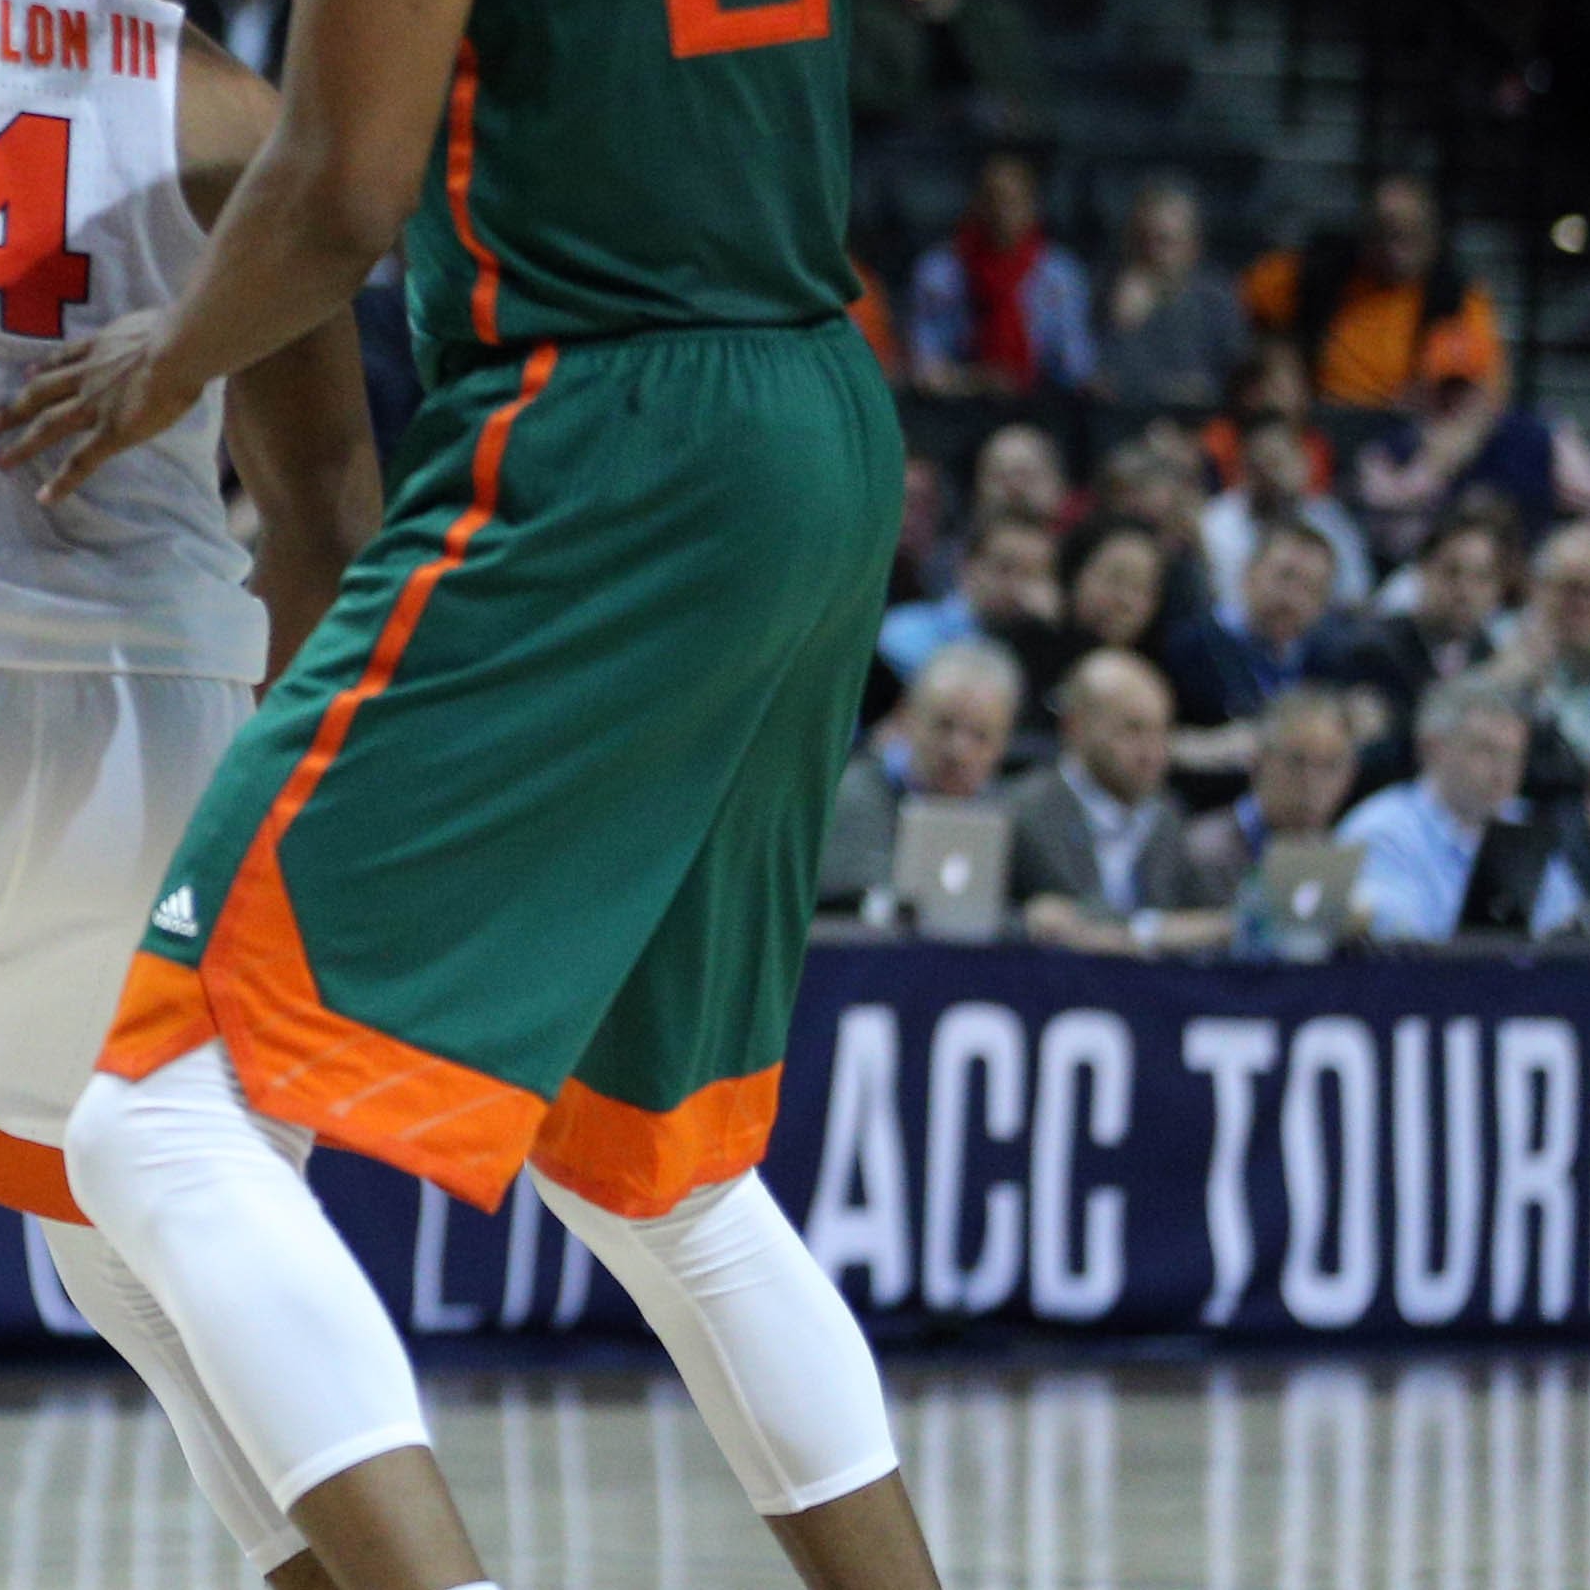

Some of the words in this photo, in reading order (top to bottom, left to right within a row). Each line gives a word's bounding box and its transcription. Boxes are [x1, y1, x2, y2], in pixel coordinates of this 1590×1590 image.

[111, 13, 158, 80] III
[803, 1002, 1136, 1322] ACC
[1182, 1014, 1589, 1328] TOUR
